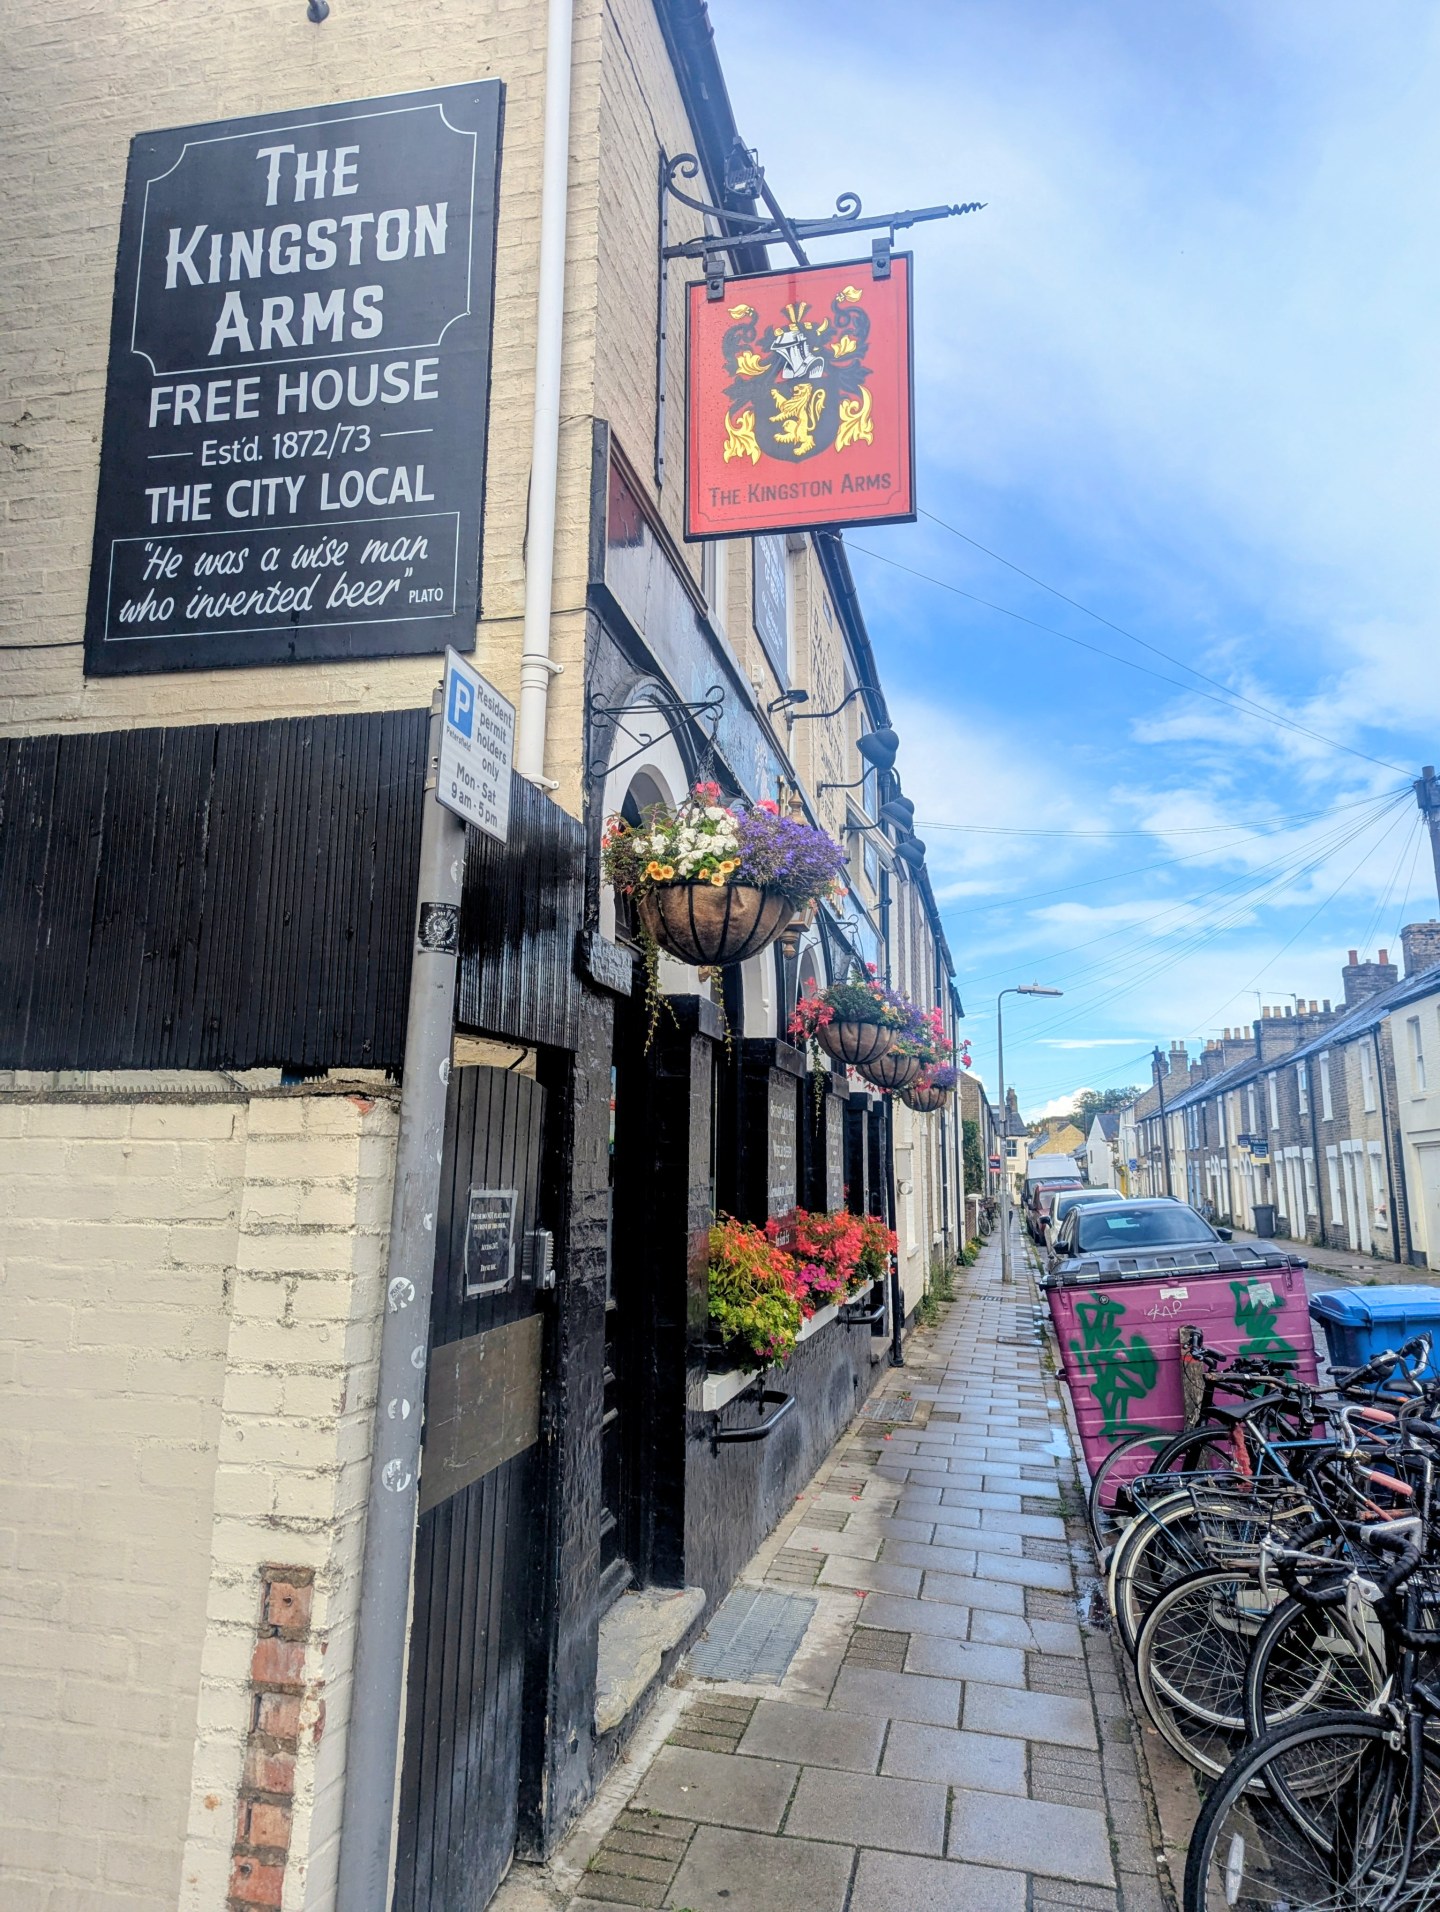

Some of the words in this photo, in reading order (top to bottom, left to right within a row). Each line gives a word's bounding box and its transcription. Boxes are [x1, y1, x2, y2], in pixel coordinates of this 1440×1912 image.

[256, 144, 360, 206] THE
[164, 202, 449, 290] KINGSTON
[208, 285, 385, 356] ARMS
[148, 376, 261, 429] FREE
[277, 357, 440, 416] HOUSE
[272, 422, 372, 461] 1872/73
[144, 484, 213, 525] THE
[226, 474, 306, 519] CITY
[320, 464, 435, 512] LOCAL
[708, 487, 741, 508] THE
[748, 479, 833, 504] KINGSTON
[841, 472, 892, 495] ARMS
[194, 547, 249, 577] was
[260, 546, 281, 572] a
[291, 536, 349, 569] wise
[360, 535, 429, 565] man
[119, 588, 175, 624] who
[186, 574, 320, 620] invented
[408, 587, 444, 605] PLATO
[454, 680, 471, 724] P
[477, 684, 512, 729] Resident
[446, 725, 472, 752] Petersfield
[477, 727, 507, 765] holders
[480, 712, 507, 745] permit
[456, 762, 475, 791] Mon
[481, 782, 497, 806] Sat
[482, 757, 500, 782] only
